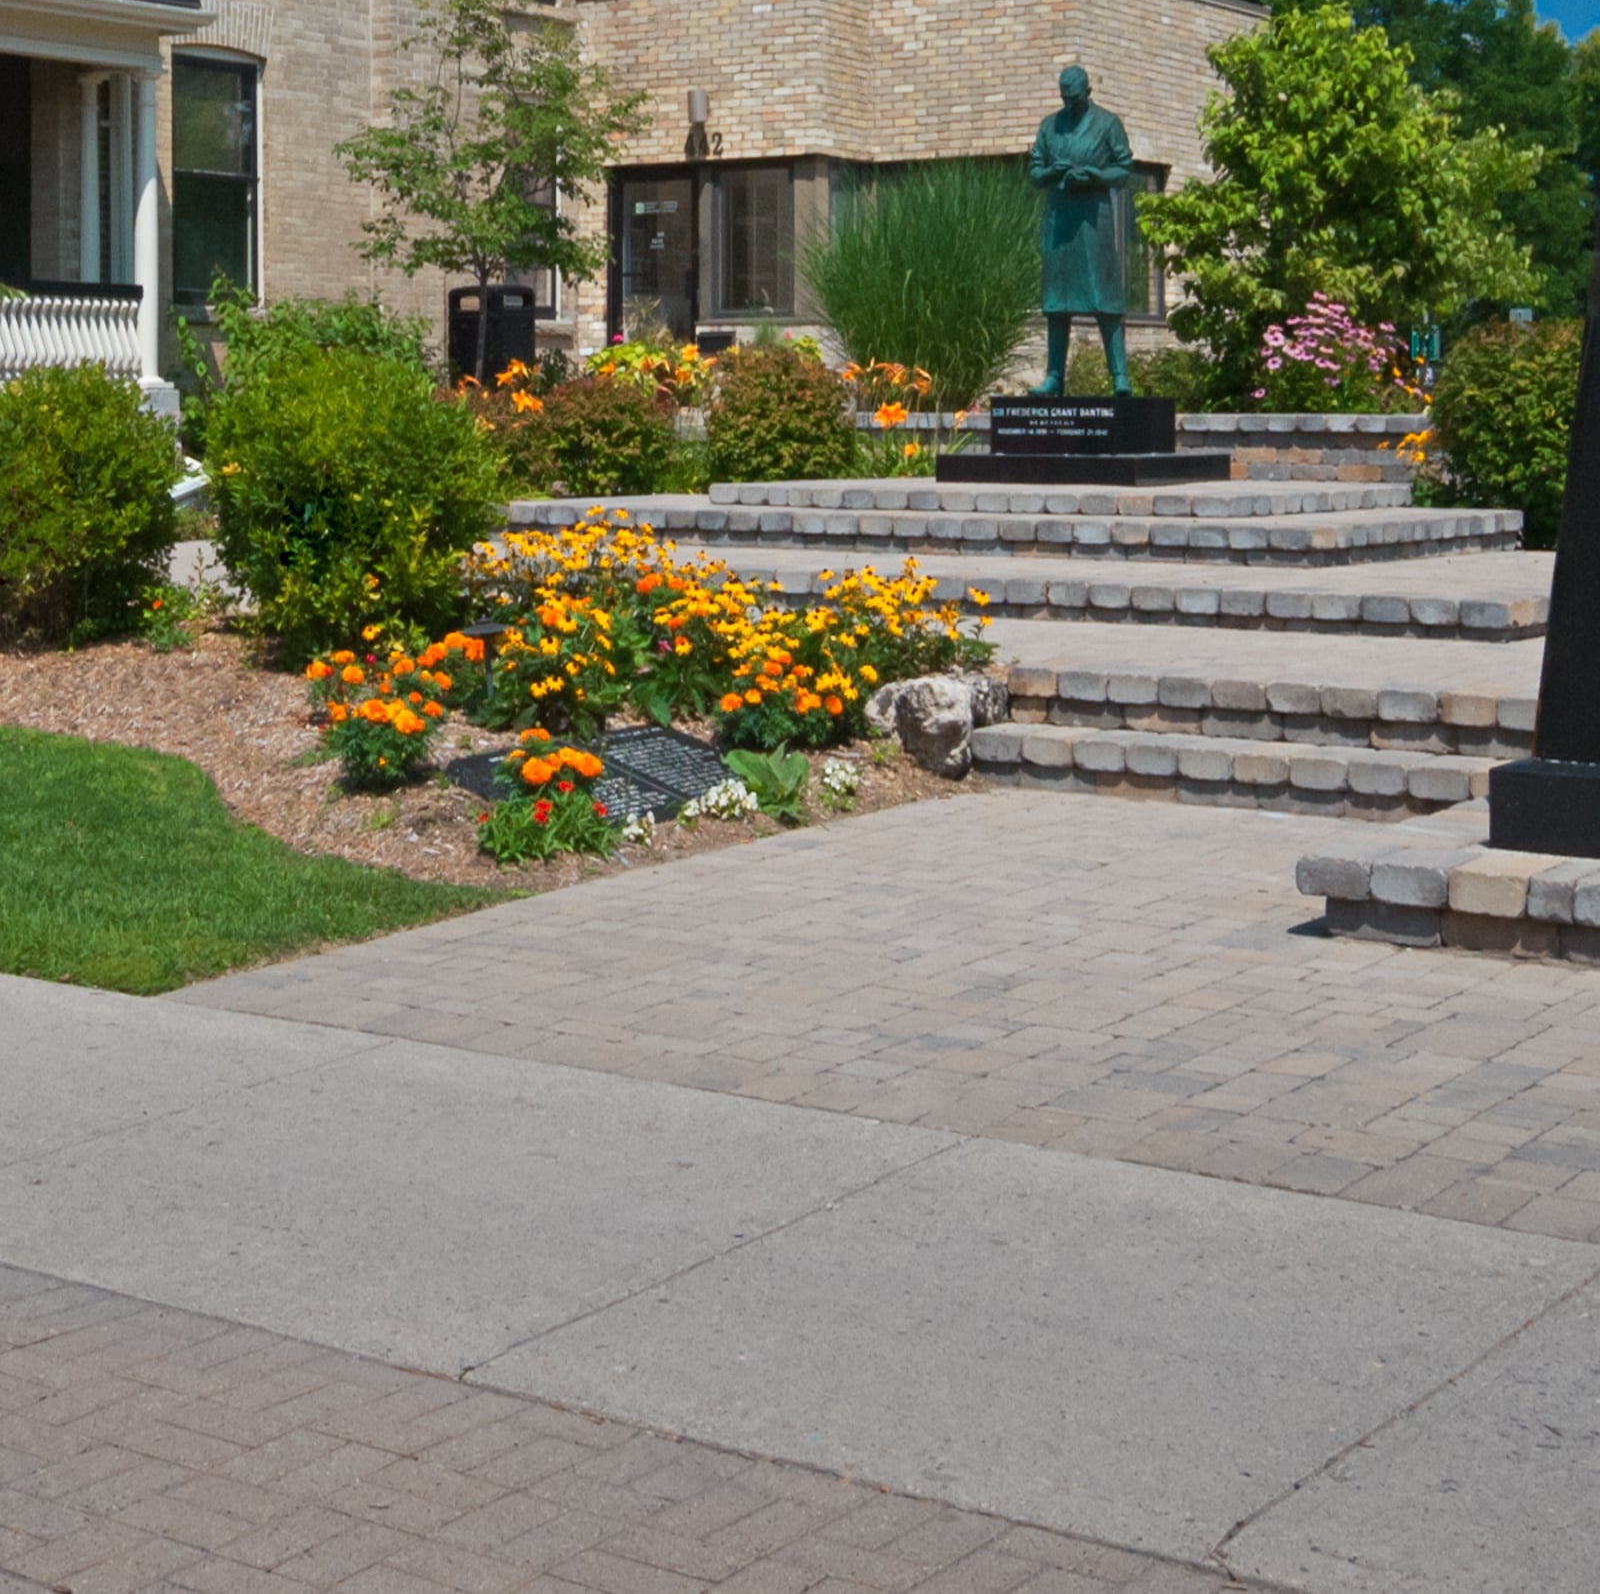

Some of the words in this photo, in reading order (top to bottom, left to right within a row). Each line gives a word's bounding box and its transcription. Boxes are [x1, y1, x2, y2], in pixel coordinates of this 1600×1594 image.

[1006, 407, 1049, 416] FREDERICK
[1050, 407, 1077, 416] GRANT
[1080, 407, 1114, 416] BANTING
